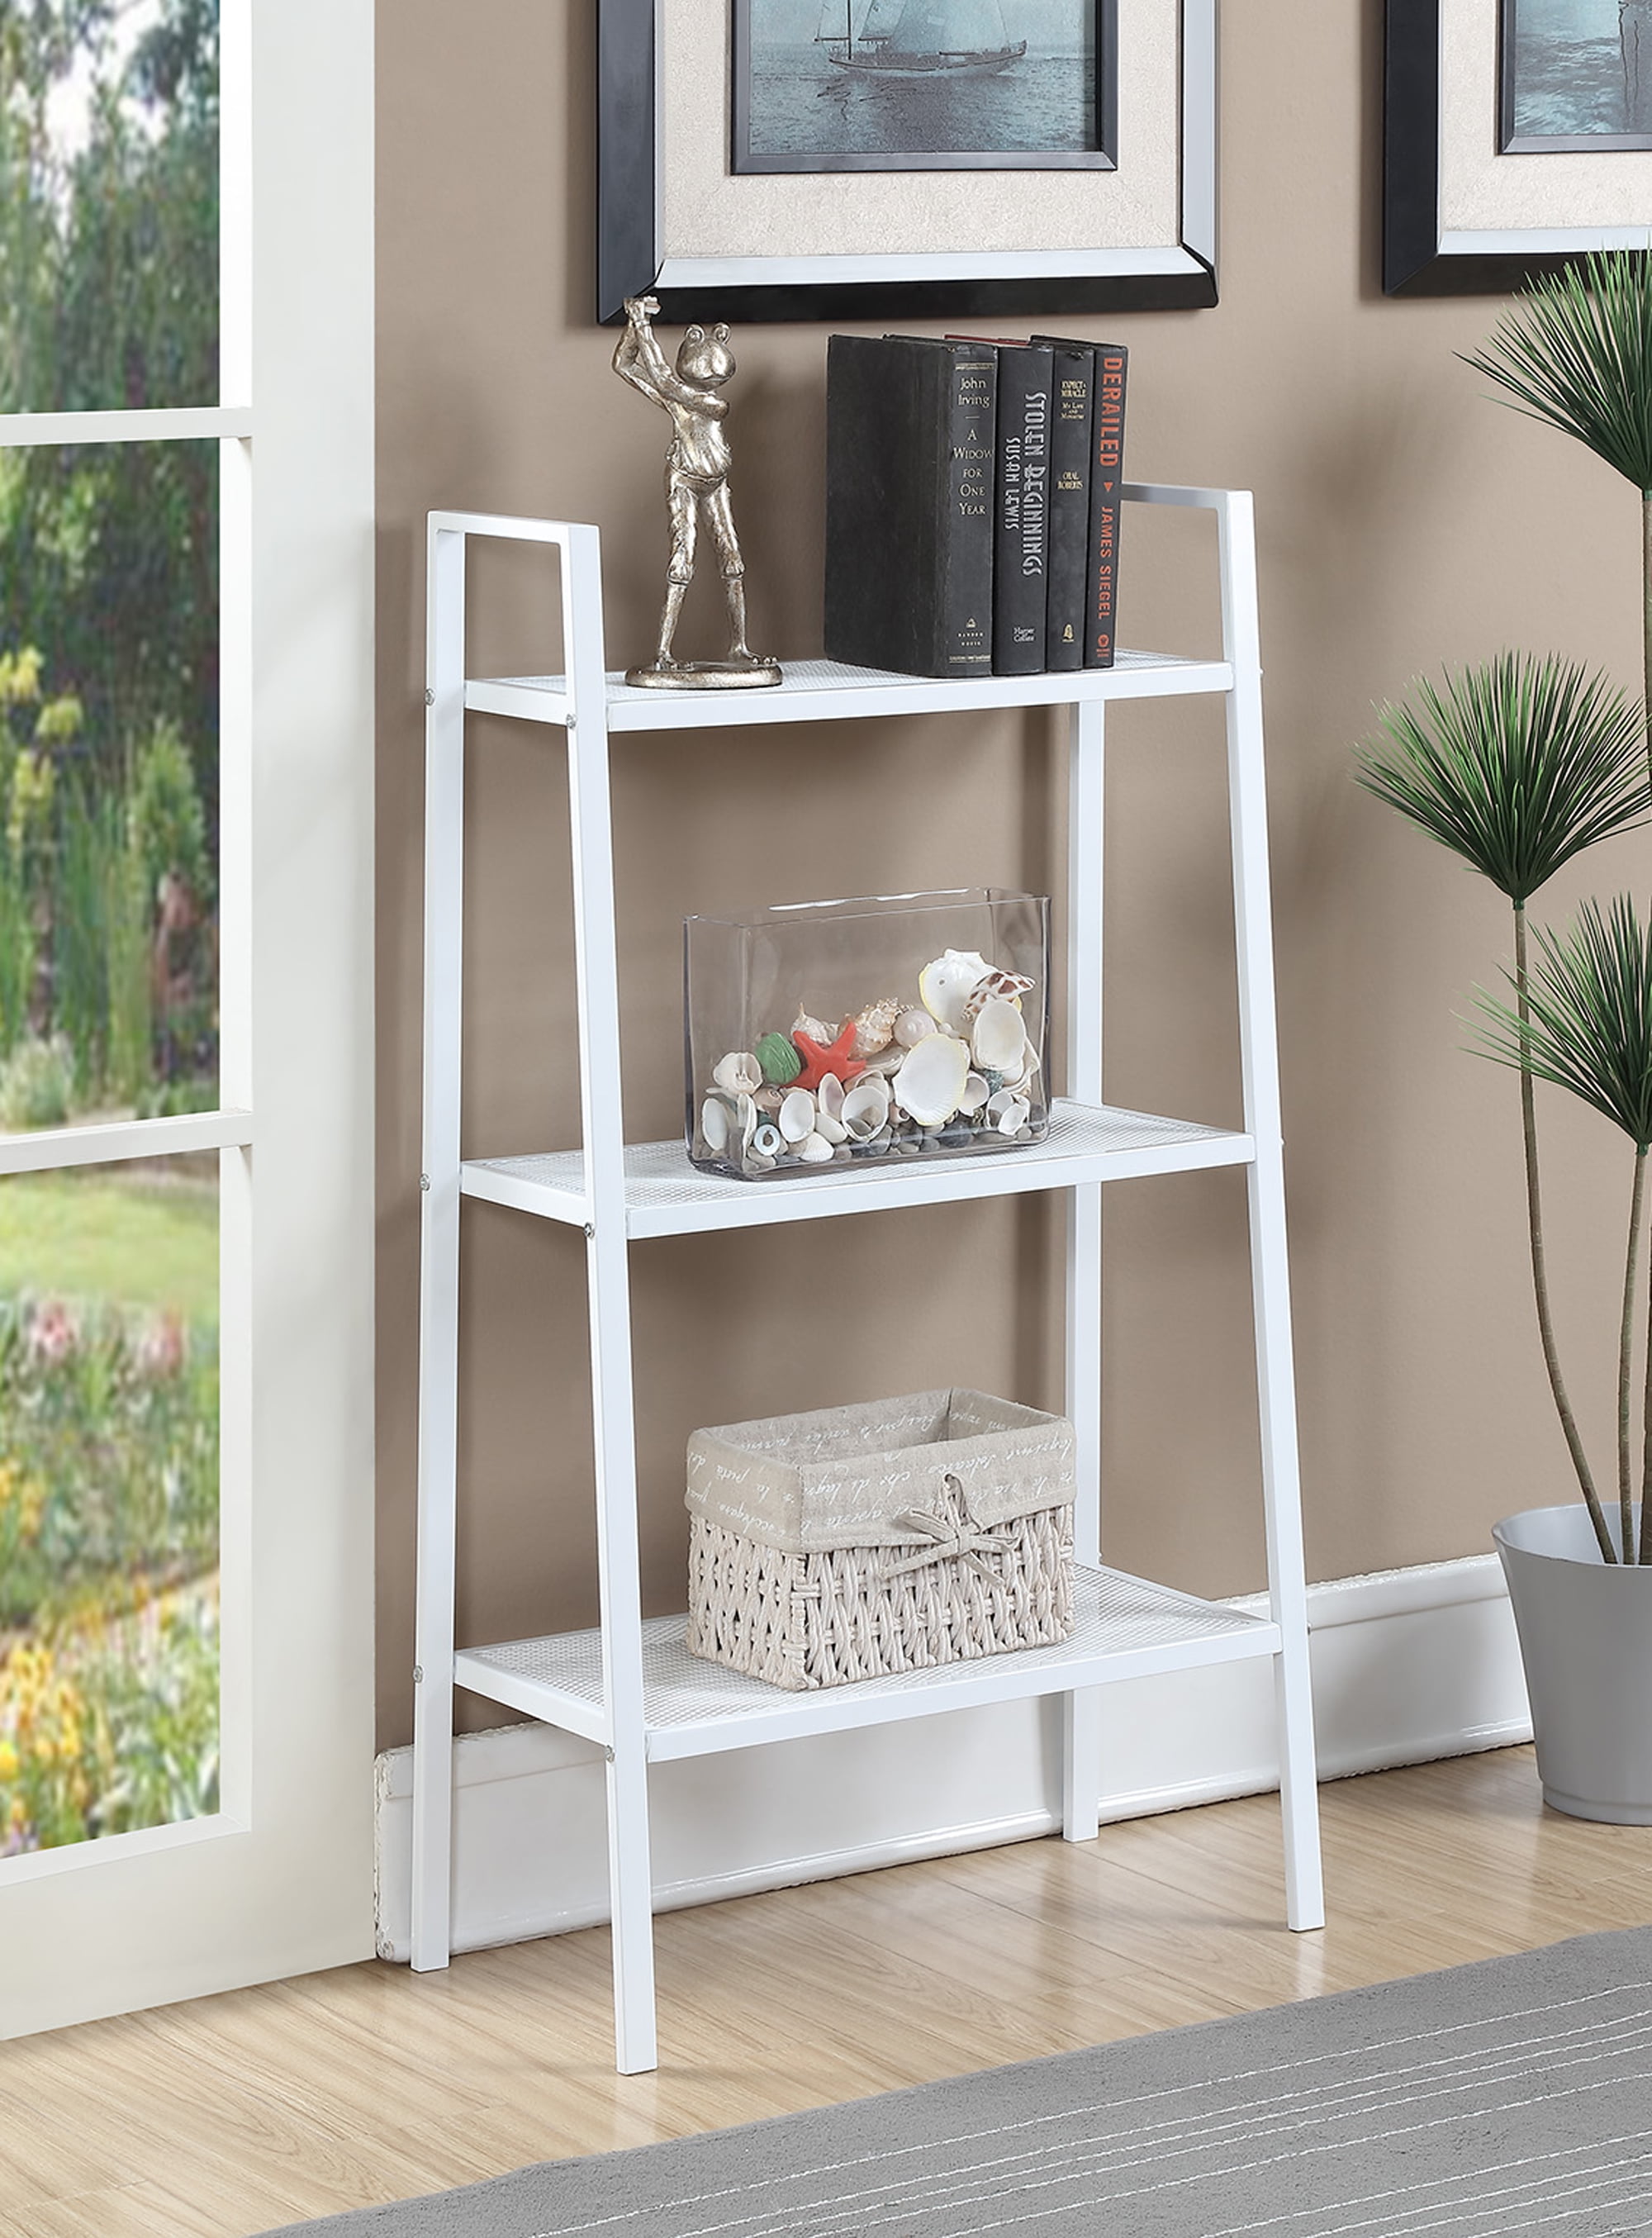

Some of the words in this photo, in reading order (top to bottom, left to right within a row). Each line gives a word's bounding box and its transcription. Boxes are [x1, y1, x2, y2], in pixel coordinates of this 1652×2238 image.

[960, 378, 986, 391] John
[957, 394, 990, 408] Irving
[1099, 357, 1123, 467] DERAILED
[967, 429, 977, 441] A
[1024, 392, 1047, 457] STOLEN
[952, 447, 993, 460] WIDOW
[1005, 436, 1021, 482] SUSAN
[963, 468, 983, 478] FOR
[959, 483, 985, 497] ONE
[959, 501, 986, 516] YEAR
[1004, 489, 1020, 530] LEWIS
[1022, 463, 1046, 576] BEGINNINGS
[1099, 506, 1114, 558] JAMES
[1098, 565, 1112, 620] SIEGEL
